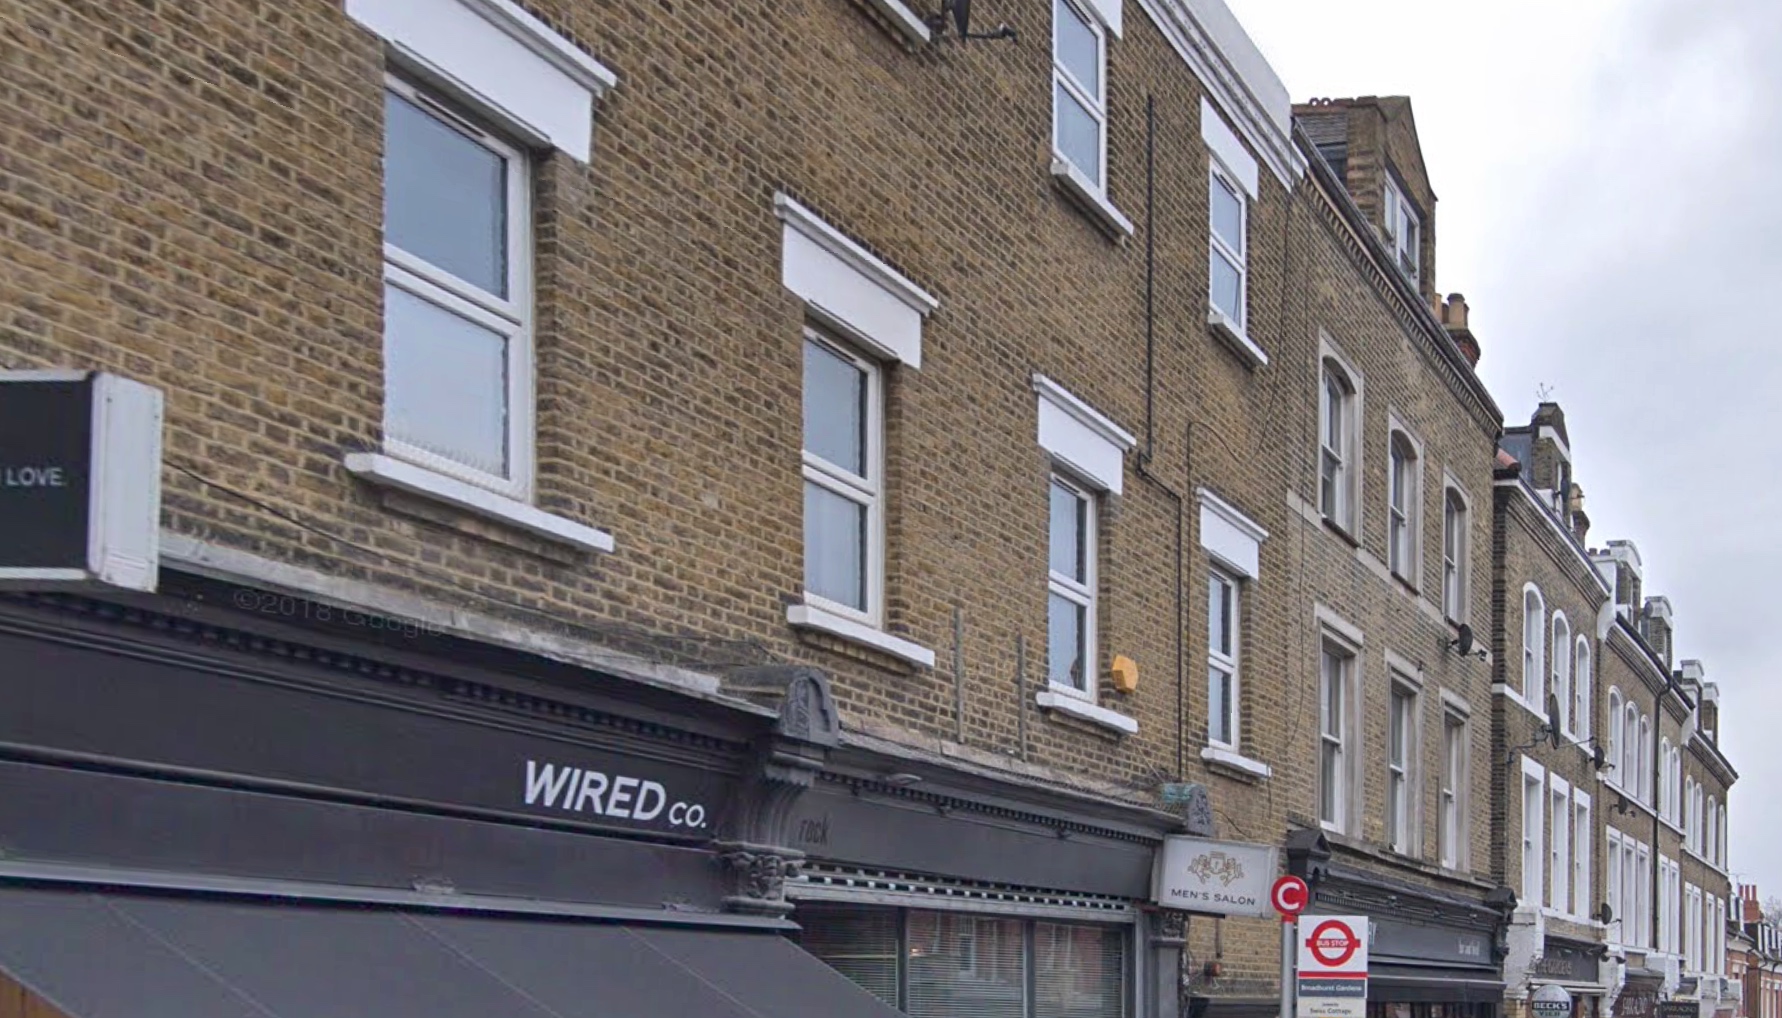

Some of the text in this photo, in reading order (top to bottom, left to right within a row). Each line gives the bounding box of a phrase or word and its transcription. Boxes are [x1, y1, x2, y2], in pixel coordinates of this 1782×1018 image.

[525, 760, 667, 821] WIRED
[1171, 888, 1256, 906] MEN'S SALON
[1277, 881, 1300, 910] C
[1331, 939, 1350, 948] STOP
[1301, 983, 1362, 992] Broadhurst Gardens
